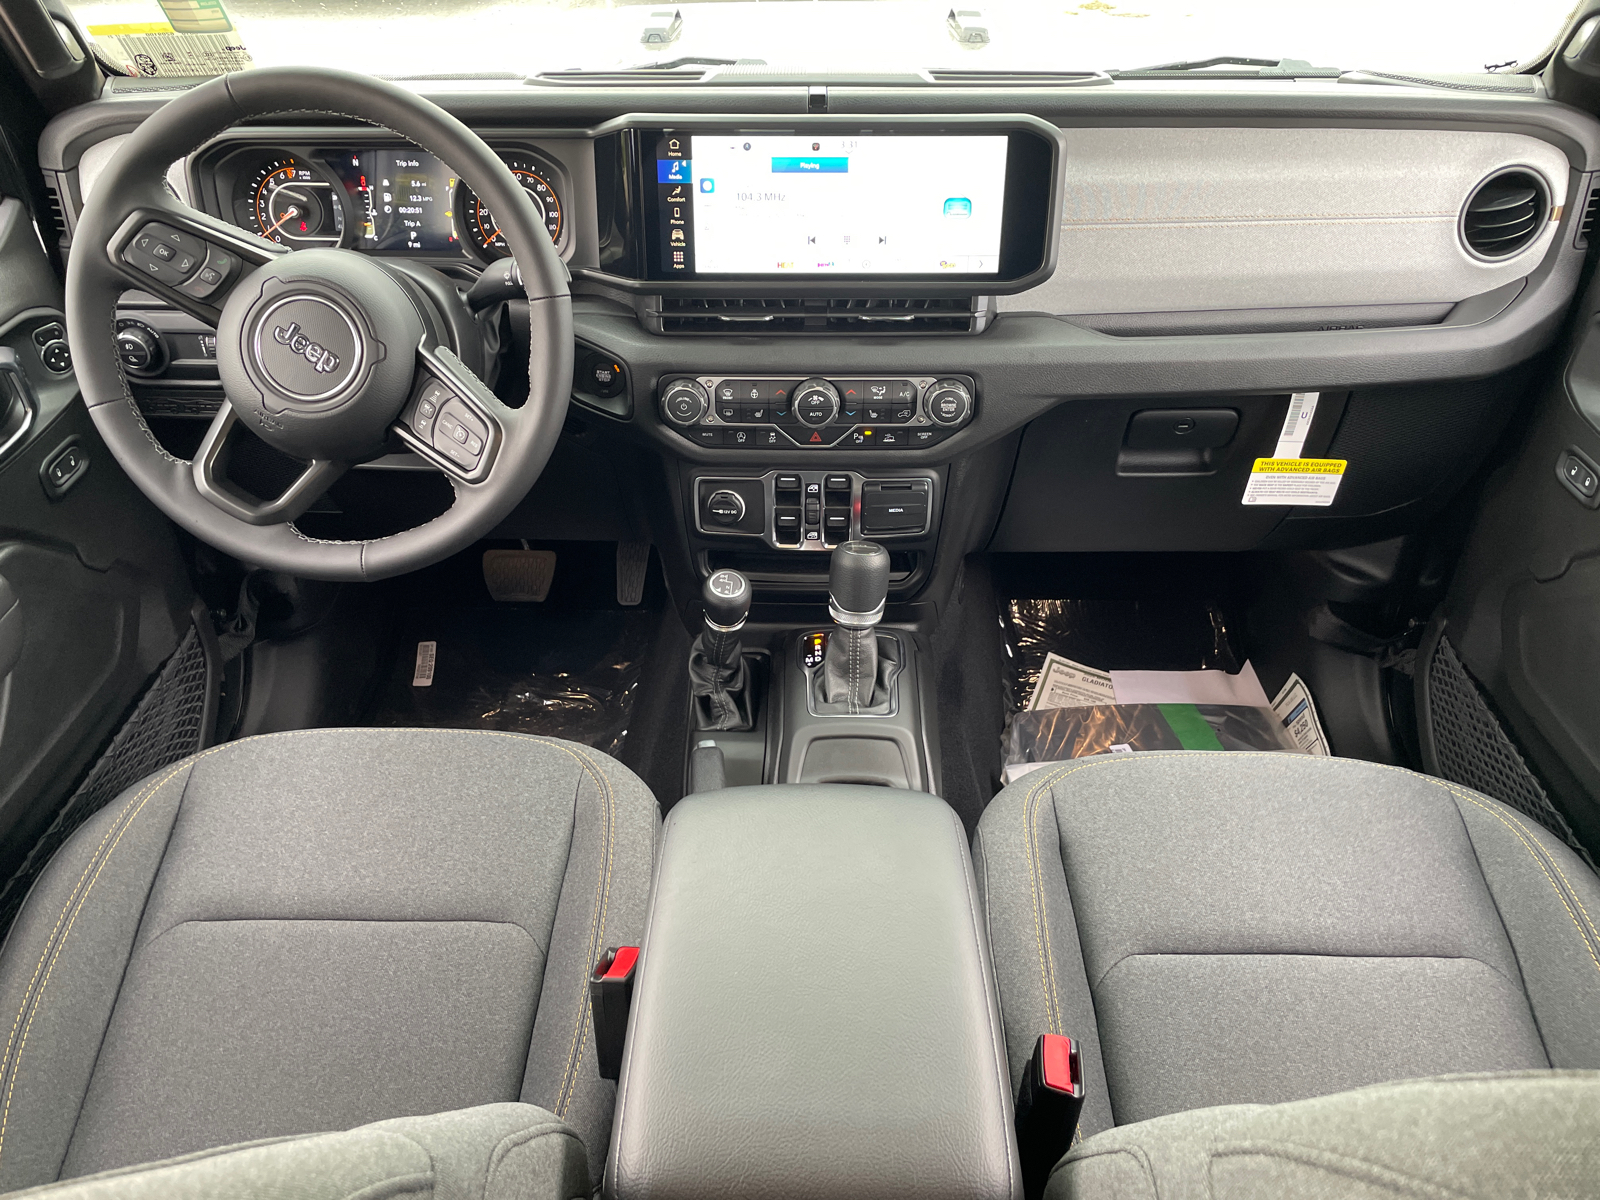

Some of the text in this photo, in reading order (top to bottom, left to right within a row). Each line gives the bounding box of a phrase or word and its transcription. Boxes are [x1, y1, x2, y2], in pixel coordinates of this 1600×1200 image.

[737, 192, 786, 201] 104.3 MHz
[410, 232, 417, 240] P
[160, 248, 169, 257] OK
[274, 322, 340, 374] Jeep
[1052, 666, 1076, 679] Jeep
